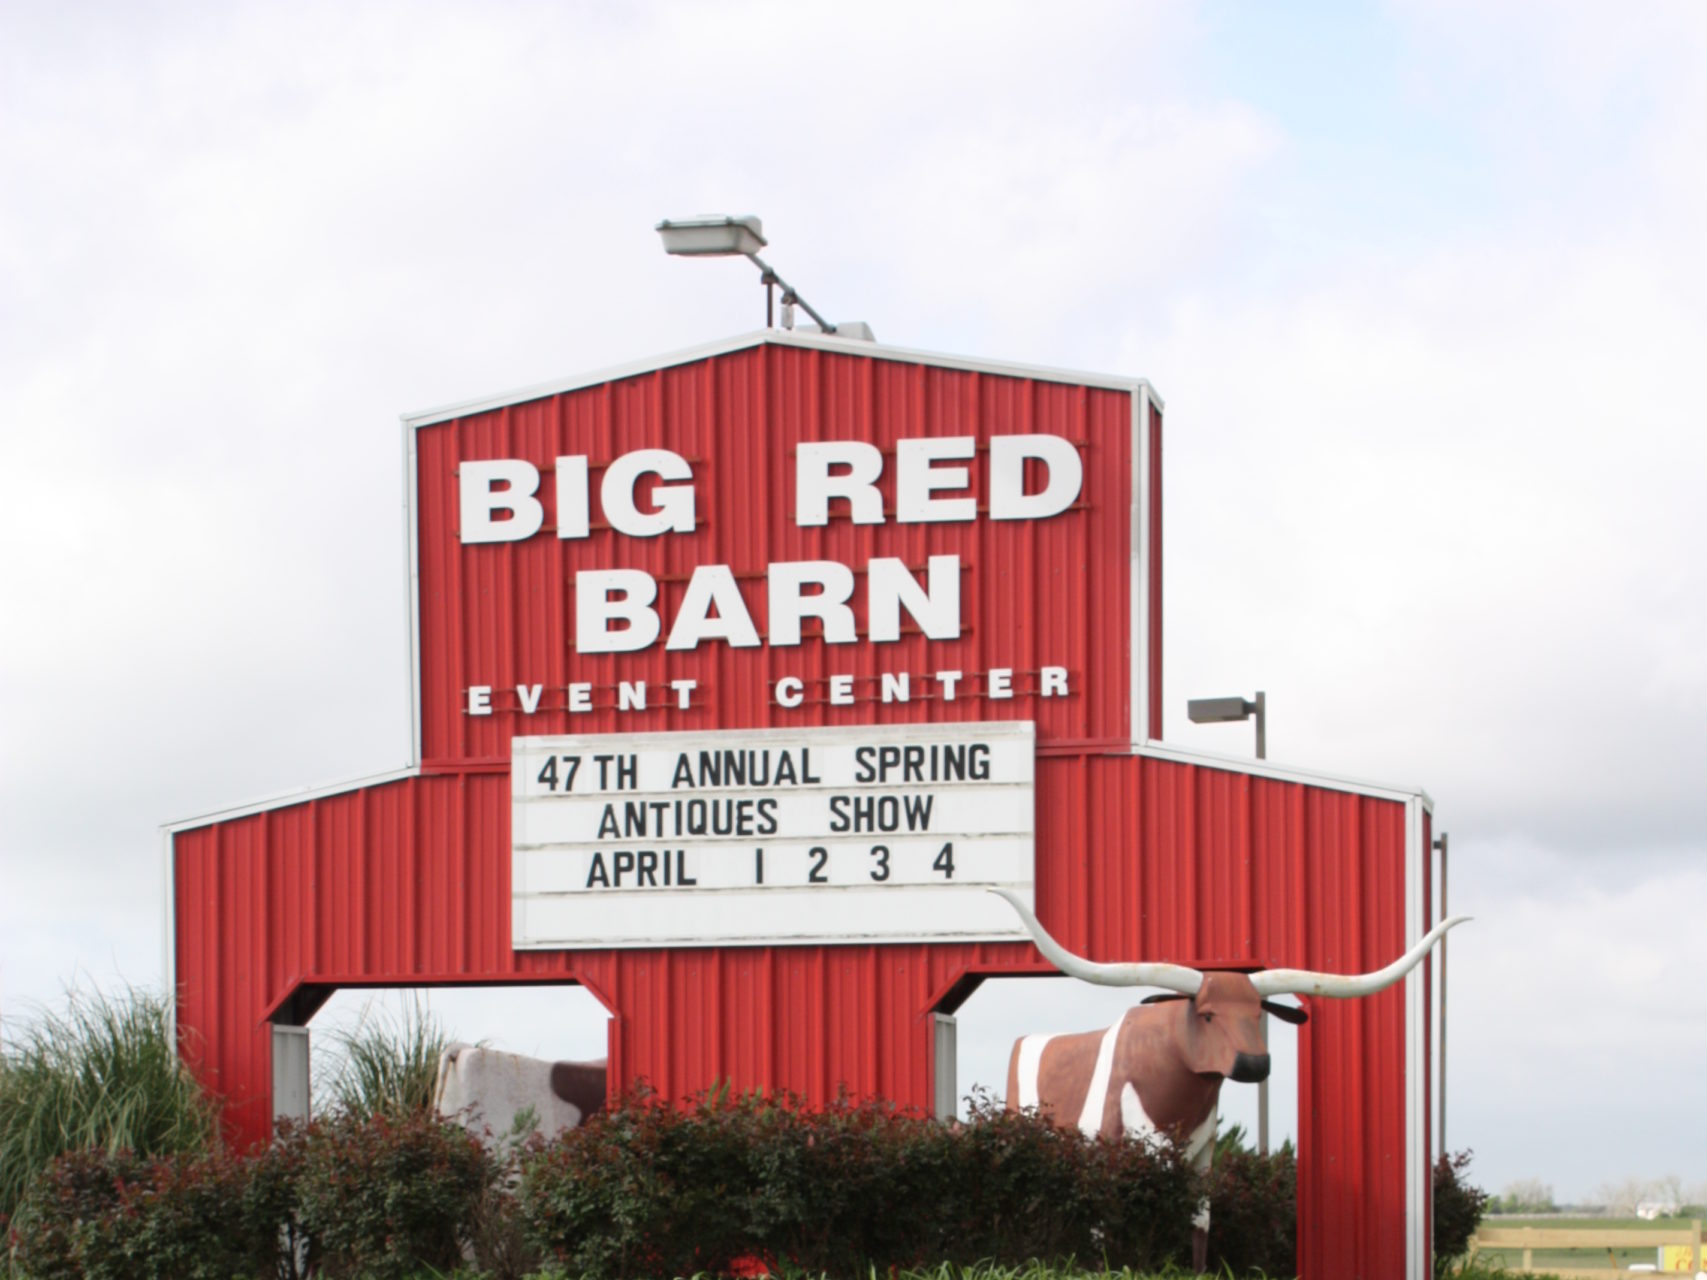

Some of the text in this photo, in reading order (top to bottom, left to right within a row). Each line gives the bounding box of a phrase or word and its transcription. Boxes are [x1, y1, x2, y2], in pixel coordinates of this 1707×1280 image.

[459, 434, 1082, 543] BIG RED
[576, 555, 960, 652] BARN
[469, 667, 1067, 714] EVENT CENTER
[537, 743, 990, 792] 47TH ANNUAL SPRING
[597, 794, 934, 839] ANTIQUES SHOW
[586, 842, 955, 888] APRIL 1 2 3 4
